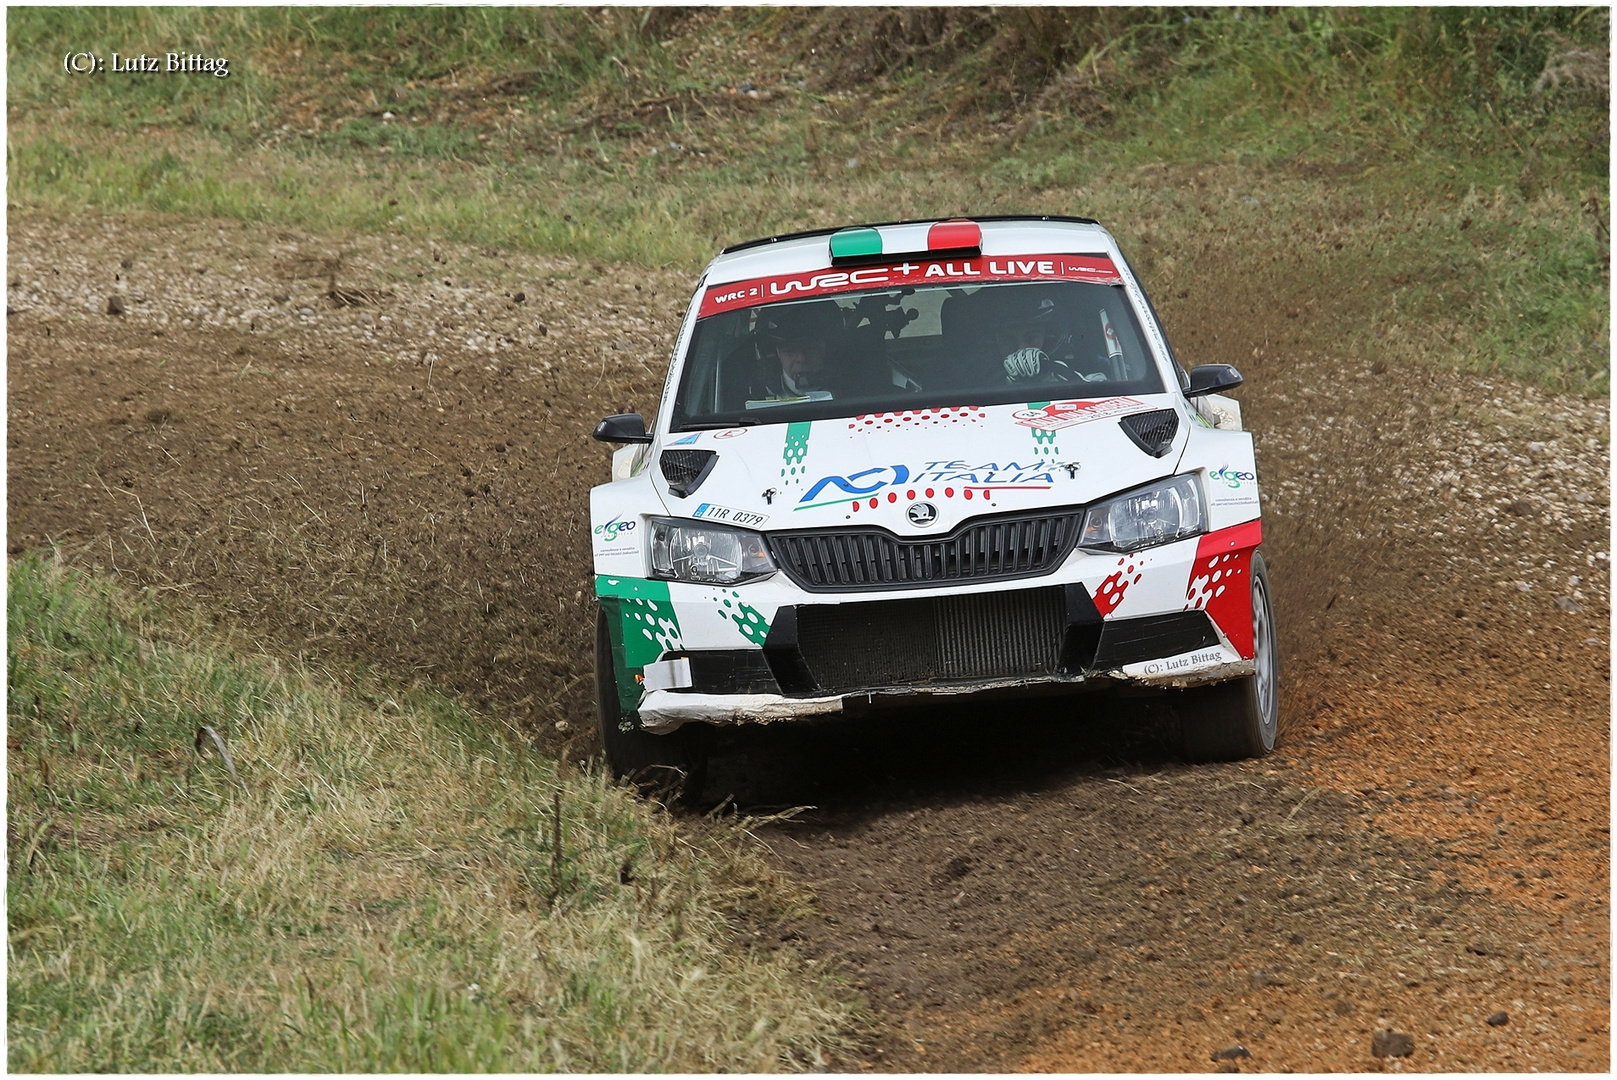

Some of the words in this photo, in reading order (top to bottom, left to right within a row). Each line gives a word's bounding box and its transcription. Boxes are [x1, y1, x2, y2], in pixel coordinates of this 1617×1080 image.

[924, 262, 981, 277] ALL
[989, 261, 1055, 275] LIVE
[715, 290, 745, 303] WRC
[749, 287, 758, 296] 2
[925, 460, 1046, 472] TEAM
[912, 471, 1055, 484] ITALIA
[707, 506, 730, 519] 11R
[732, 511, 764, 526] 0379
